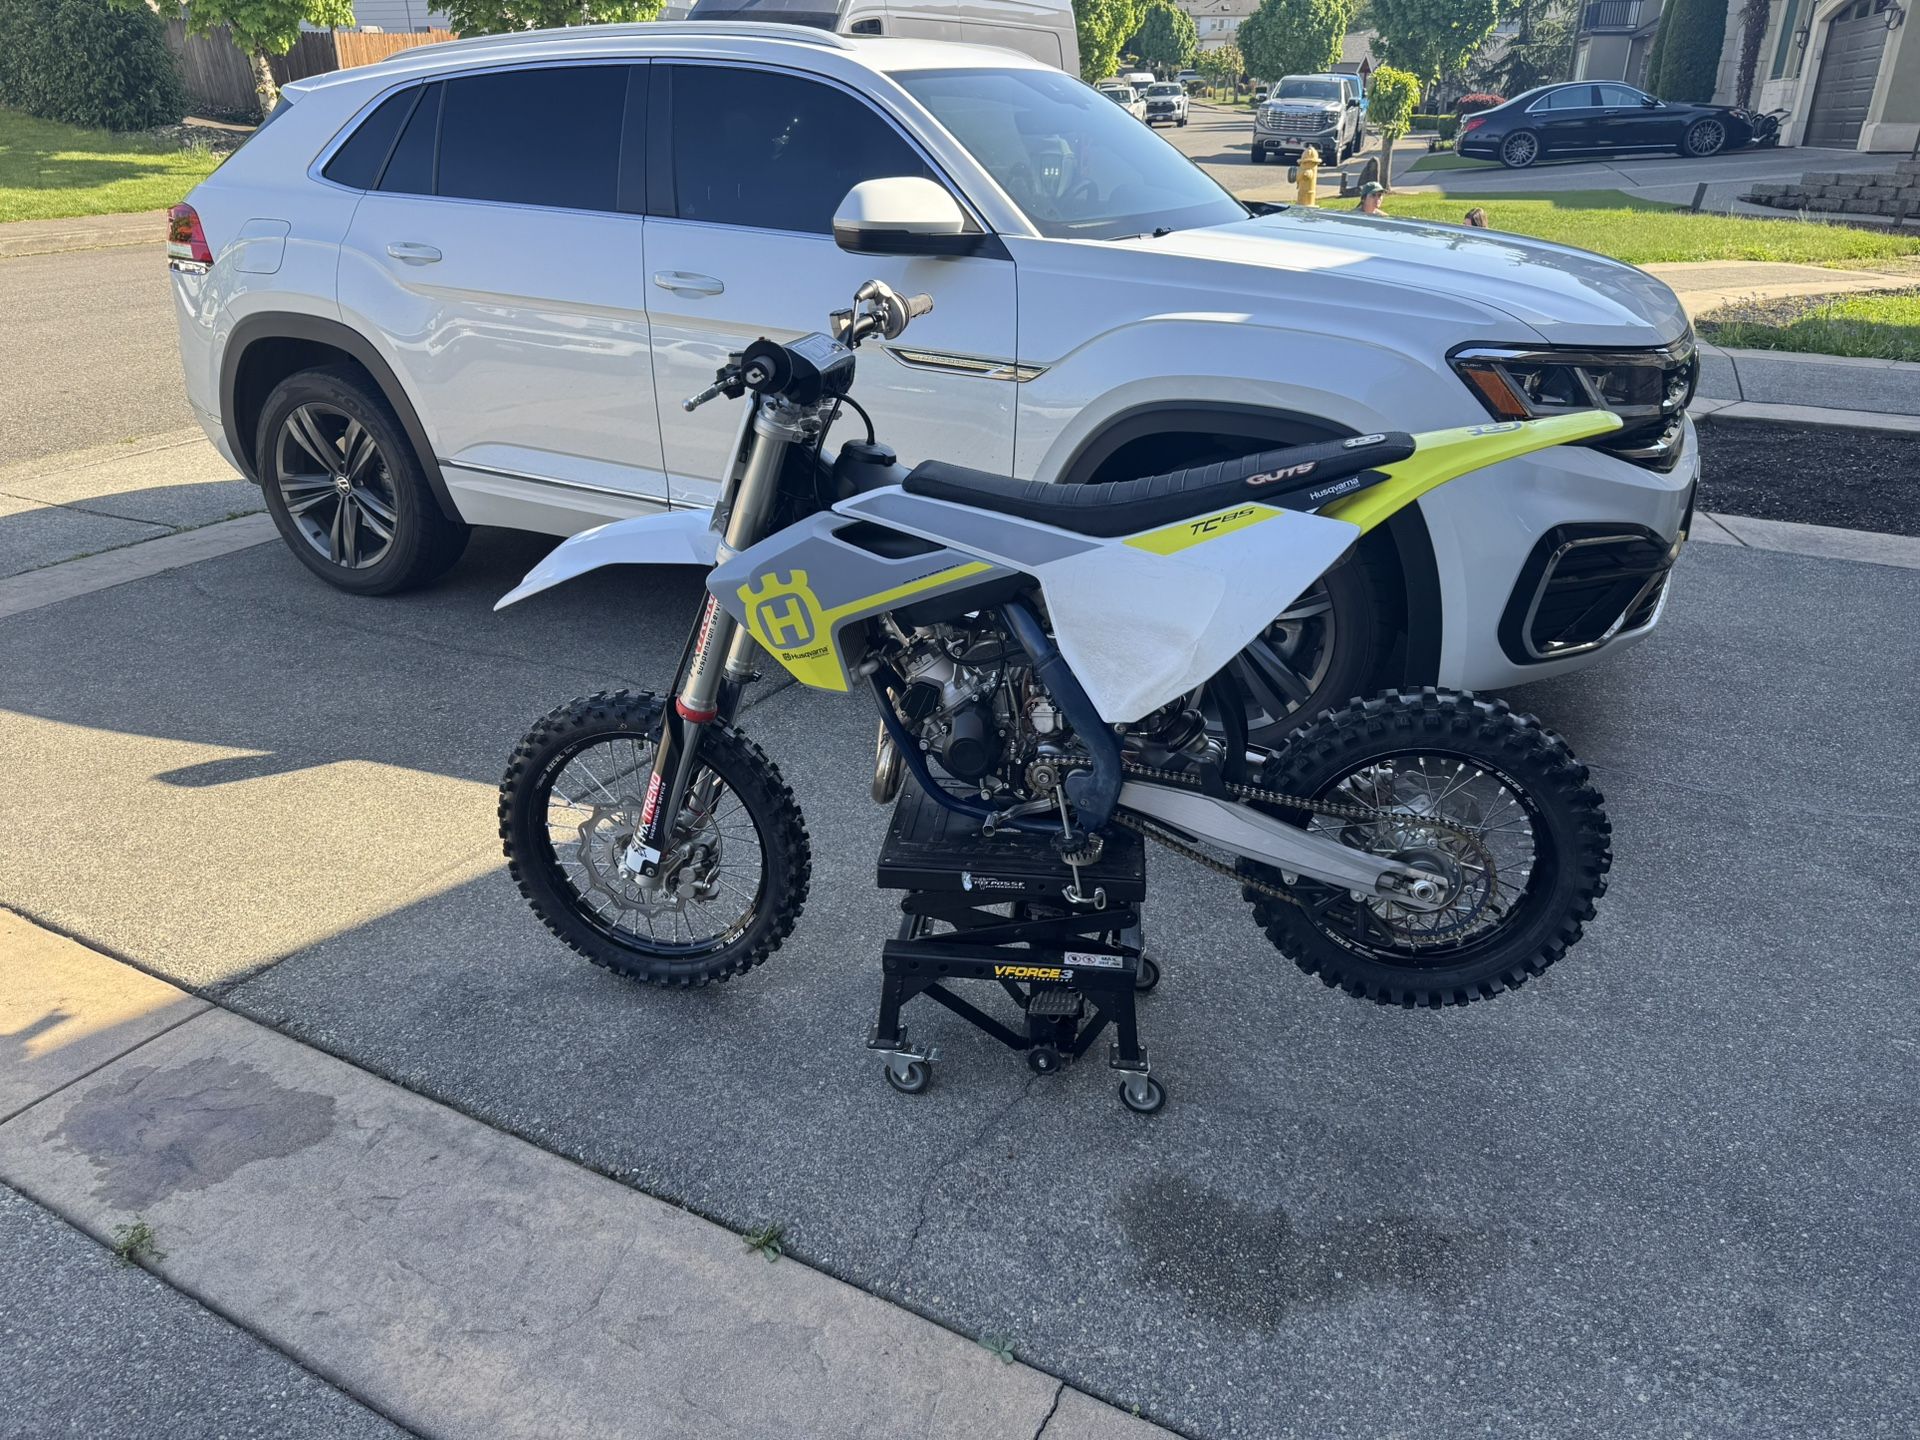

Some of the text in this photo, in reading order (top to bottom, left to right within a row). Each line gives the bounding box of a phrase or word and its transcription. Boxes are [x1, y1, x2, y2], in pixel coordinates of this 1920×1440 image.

[1246, 461, 1316, 485] GUTS
[1310, 478, 1359, 500] Husqvarna
[1191, 507, 1255, 535] TC85
[697, 627, 715, 676] Suspension
[791, 647, 829, 660] Husqvarna
[994, 965, 1074, 978] VFORCE3
